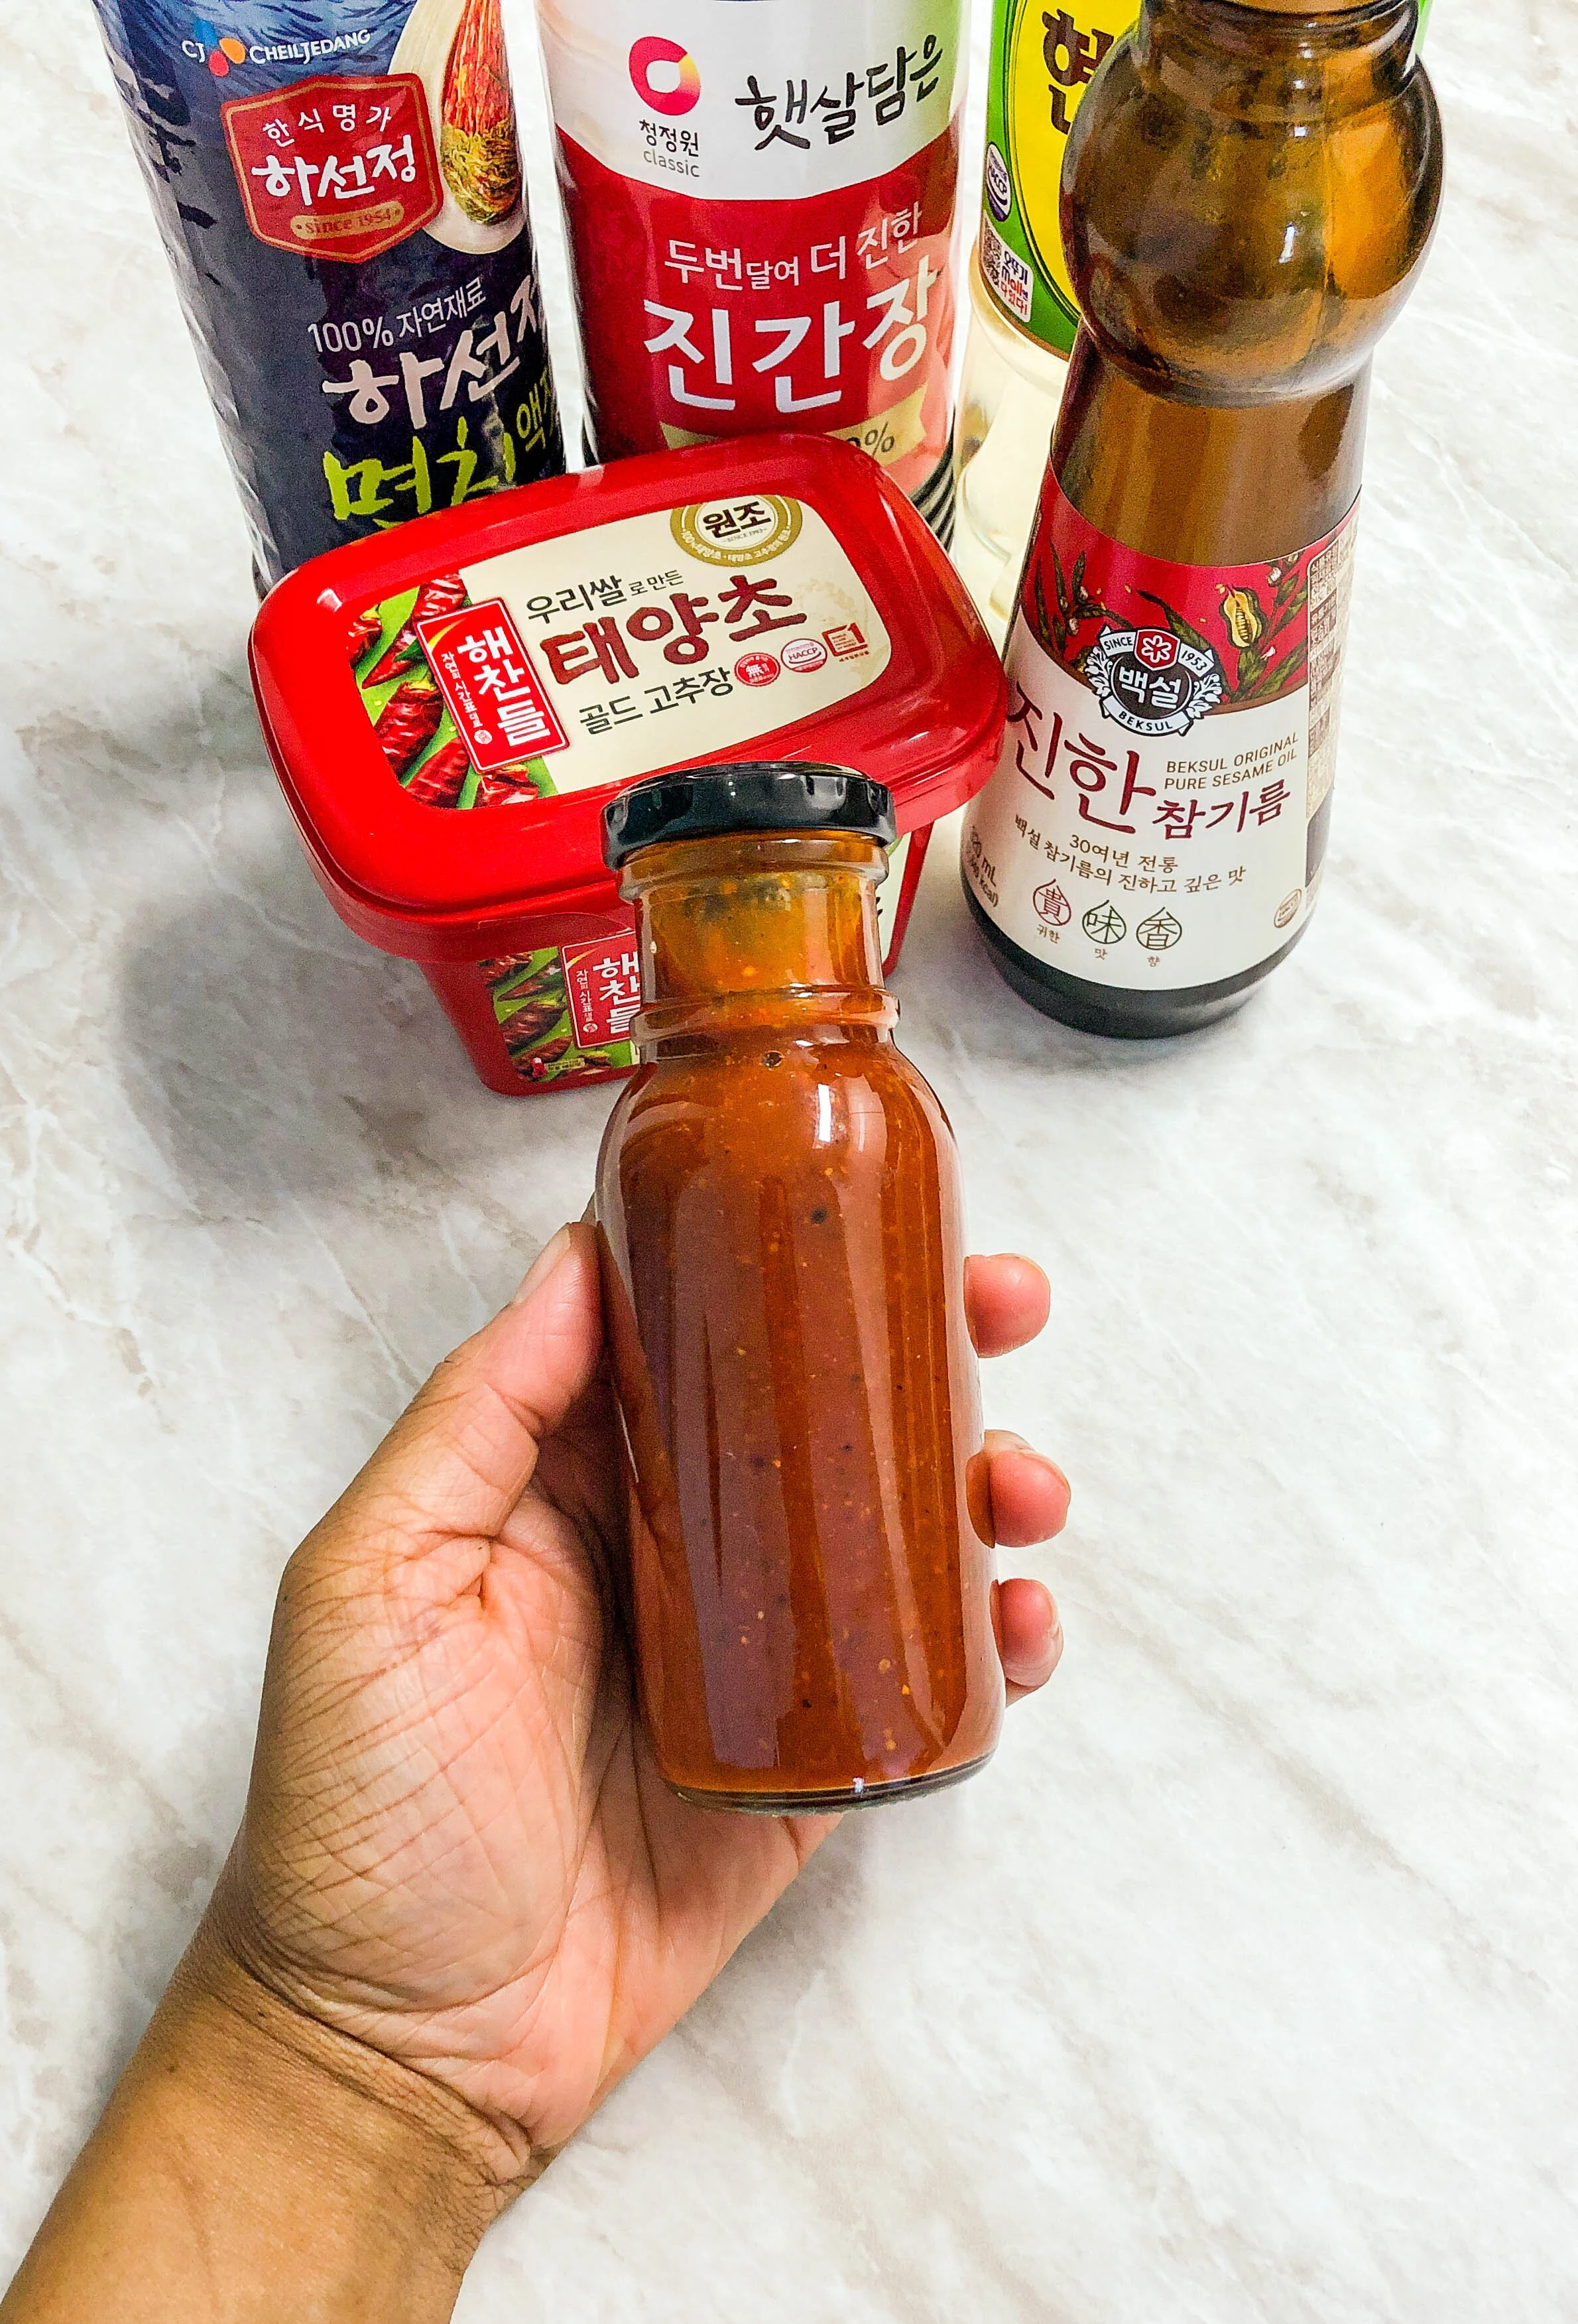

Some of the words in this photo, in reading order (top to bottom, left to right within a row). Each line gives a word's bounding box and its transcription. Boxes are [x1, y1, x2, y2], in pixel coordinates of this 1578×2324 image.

[182, 40, 206, 63] CJ
[249, 29, 371, 64] CHEILJEDANG
[734, 34, 943, 151] 햇살담은
[639, 119, 699, 157] 청정원
[251, 135, 416, 206] 하선정
[643, 149, 699, 178] classic
[810, 235, 847, 280] 더
[857, 201, 922, 269] 진한
[308, 316, 394, 352] 100%
[396, 276, 486, 338] 자연재료
[643, 254, 944, 414] 진간장
[702, 500, 772, 538] 원조
[540, 574, 808, 686] 태양초
[788, 647, 818, 661] HACCP
[1103, 636, 1133, 651] SINCE
[1181, 649, 1208, 671] 1953
[456, 625, 552, 747] 해찬들
[579, 695, 643, 735] 골드
[643, 666, 734, 715] 고추장
[1118, 666, 1182, 709] 백설
[1118, 710, 1174, 731] BEKSUL
[1006, 682, 1157, 834] 진한
[1152, 778, 1291, 840] 참기름
[1164, 777, 1207, 790] PURE
[1212, 760, 1274, 787] SESAME
[1278, 748, 1297, 767] OIL
[1166, 757, 1229, 773] BEKSUL
[1233, 731, 1299, 766] ORIGINAL
[1014, 814, 1042, 851] 백설
[1043, 839, 1113, 887] 참기름의
[1118, 873, 1178, 894] 진하고
[1183, 873, 1223, 894] 깊은
[1227, 865, 1247, 887] 맛
[1068, 833, 1130, 869] 30여년
[1138, 854, 1179, 874] 전통
[1036, 924, 1061, 944] 귀한
[1086, 909, 1123, 943] 味
[1138, 910, 1180, 949] 香
